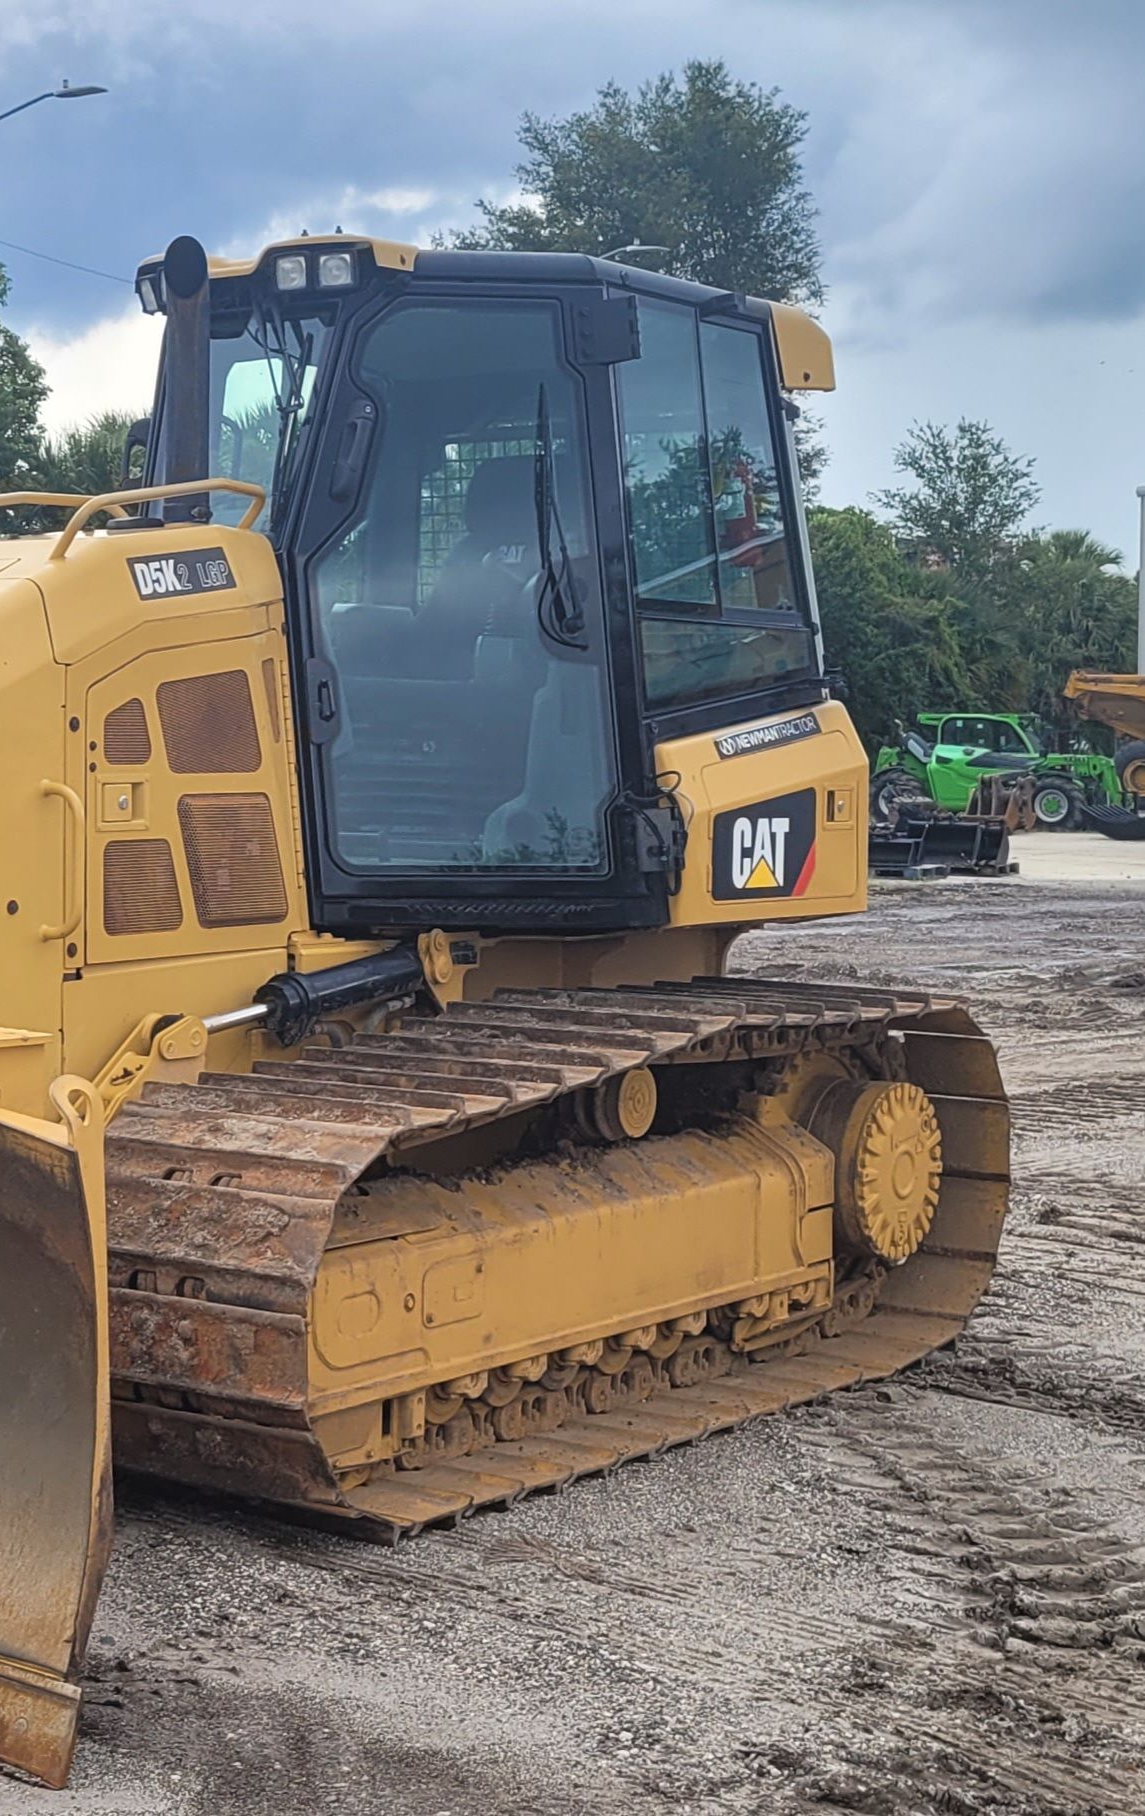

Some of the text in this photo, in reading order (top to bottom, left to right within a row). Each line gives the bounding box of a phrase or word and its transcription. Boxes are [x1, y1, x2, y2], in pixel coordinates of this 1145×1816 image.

[133, 559, 229, 595] D5K2 LGP
[732, 817, 790, 889] CAT
